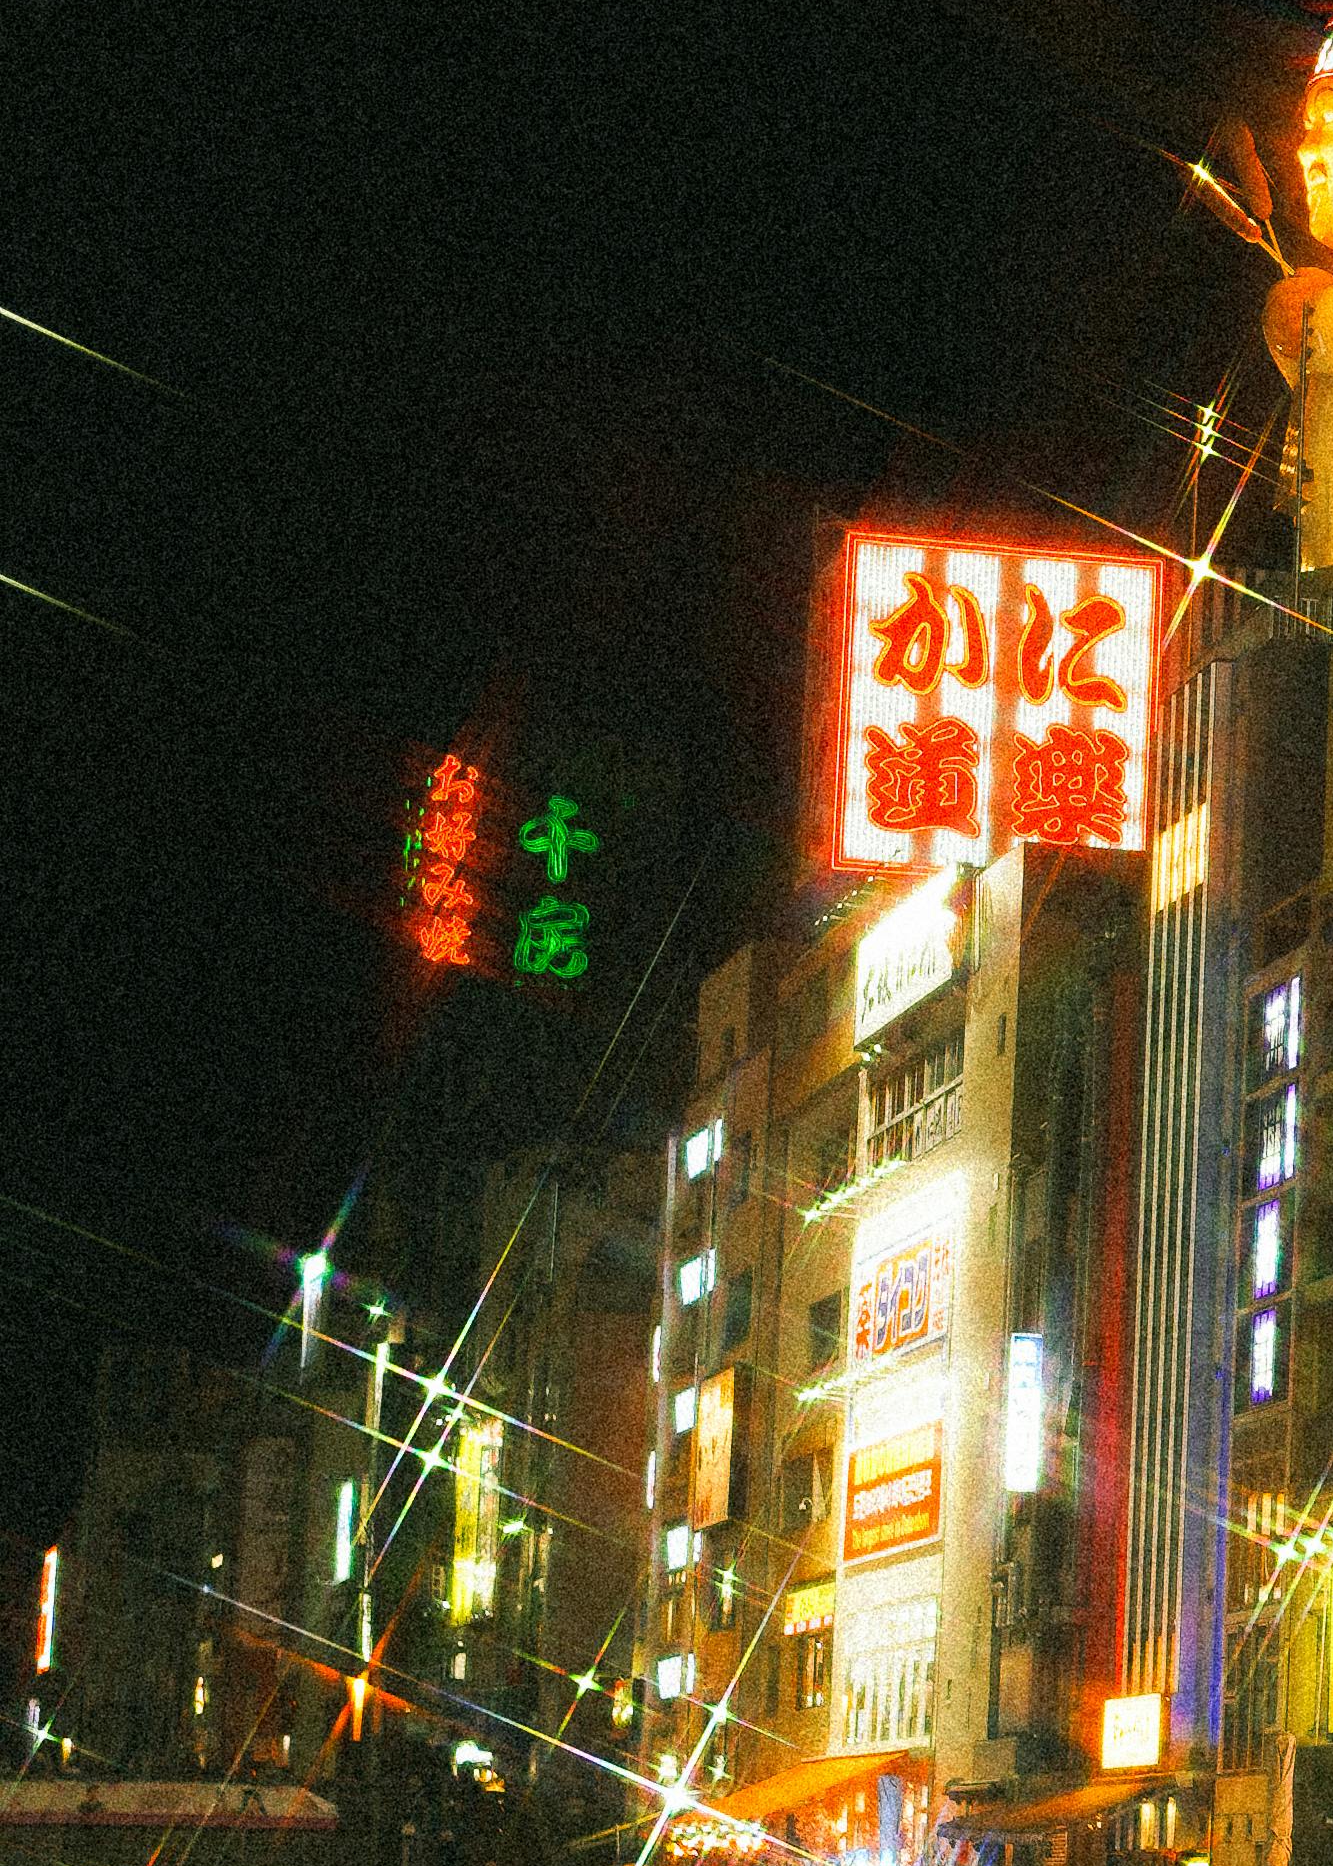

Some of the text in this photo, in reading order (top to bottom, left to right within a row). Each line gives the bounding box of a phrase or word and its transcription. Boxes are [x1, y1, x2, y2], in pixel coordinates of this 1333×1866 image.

[869, 571, 1128, 713] かに
[419, 754, 480, 965] お好み焼
